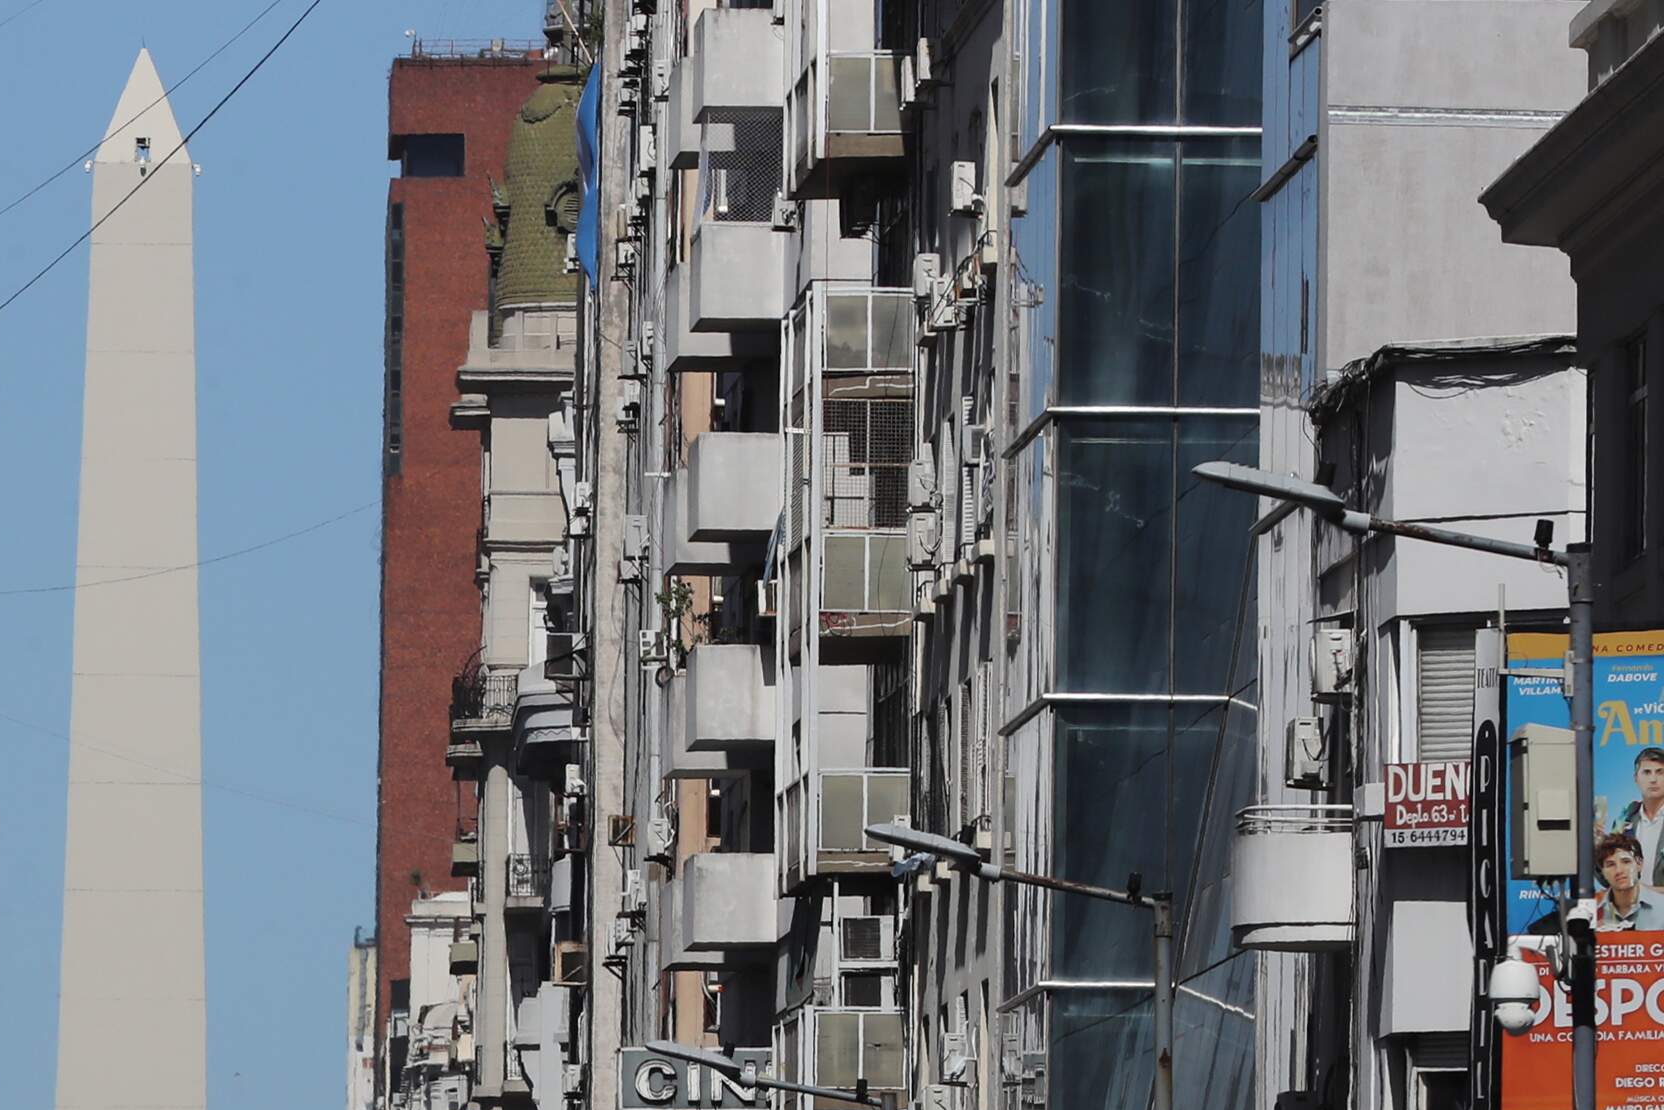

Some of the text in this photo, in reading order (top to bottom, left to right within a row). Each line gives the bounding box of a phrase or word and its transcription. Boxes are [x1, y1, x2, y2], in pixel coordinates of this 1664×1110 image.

[1607, 672, 1658, 683] DABOVE
[1519, 686, 1563, 696] VILLAM
[1529, 1032, 1554, 1043] UNA
[1557, 1031, 1616, 1042] CODIA
[1615, 1076, 1655, 1088] DIEGO
